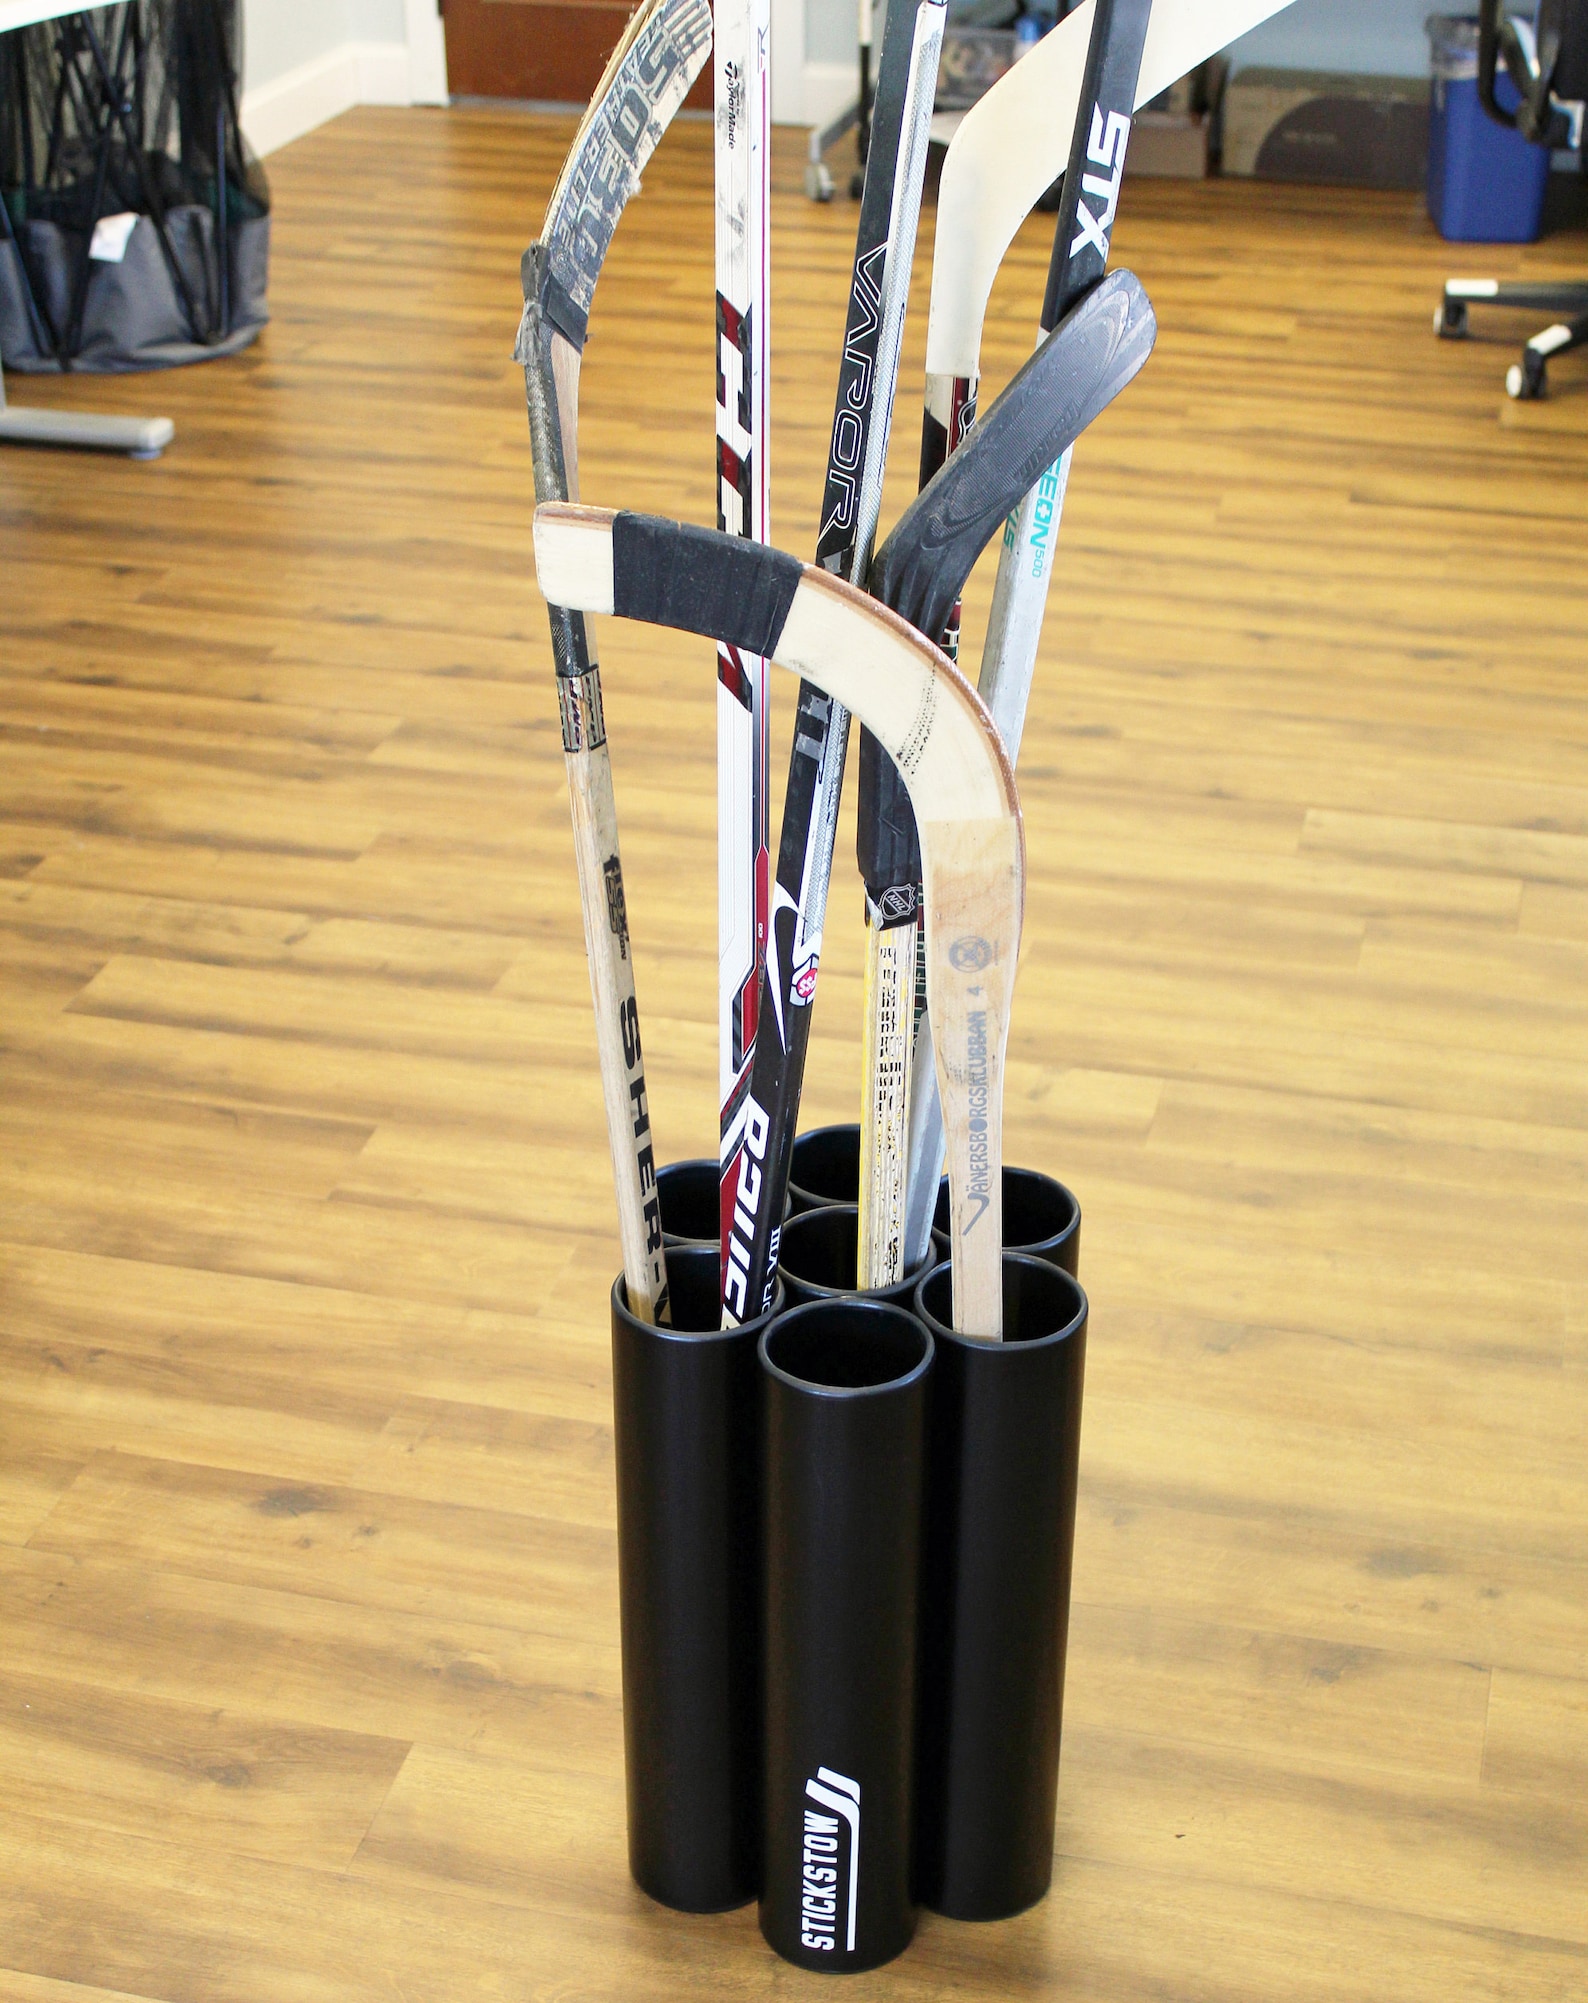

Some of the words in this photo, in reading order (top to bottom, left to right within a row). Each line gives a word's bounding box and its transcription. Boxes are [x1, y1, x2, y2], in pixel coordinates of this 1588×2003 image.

[725, 61, 738, 150] TaylorMade
[1069, 101, 1131, 263] STX
[816, 241, 889, 549] VAPOR
[1032, 547, 1046, 579] 500
[887, 894, 906, 911] NHL
[967, 985, 983, 998] 4
[802, 1810, 839, 1951] STICKSTOW
